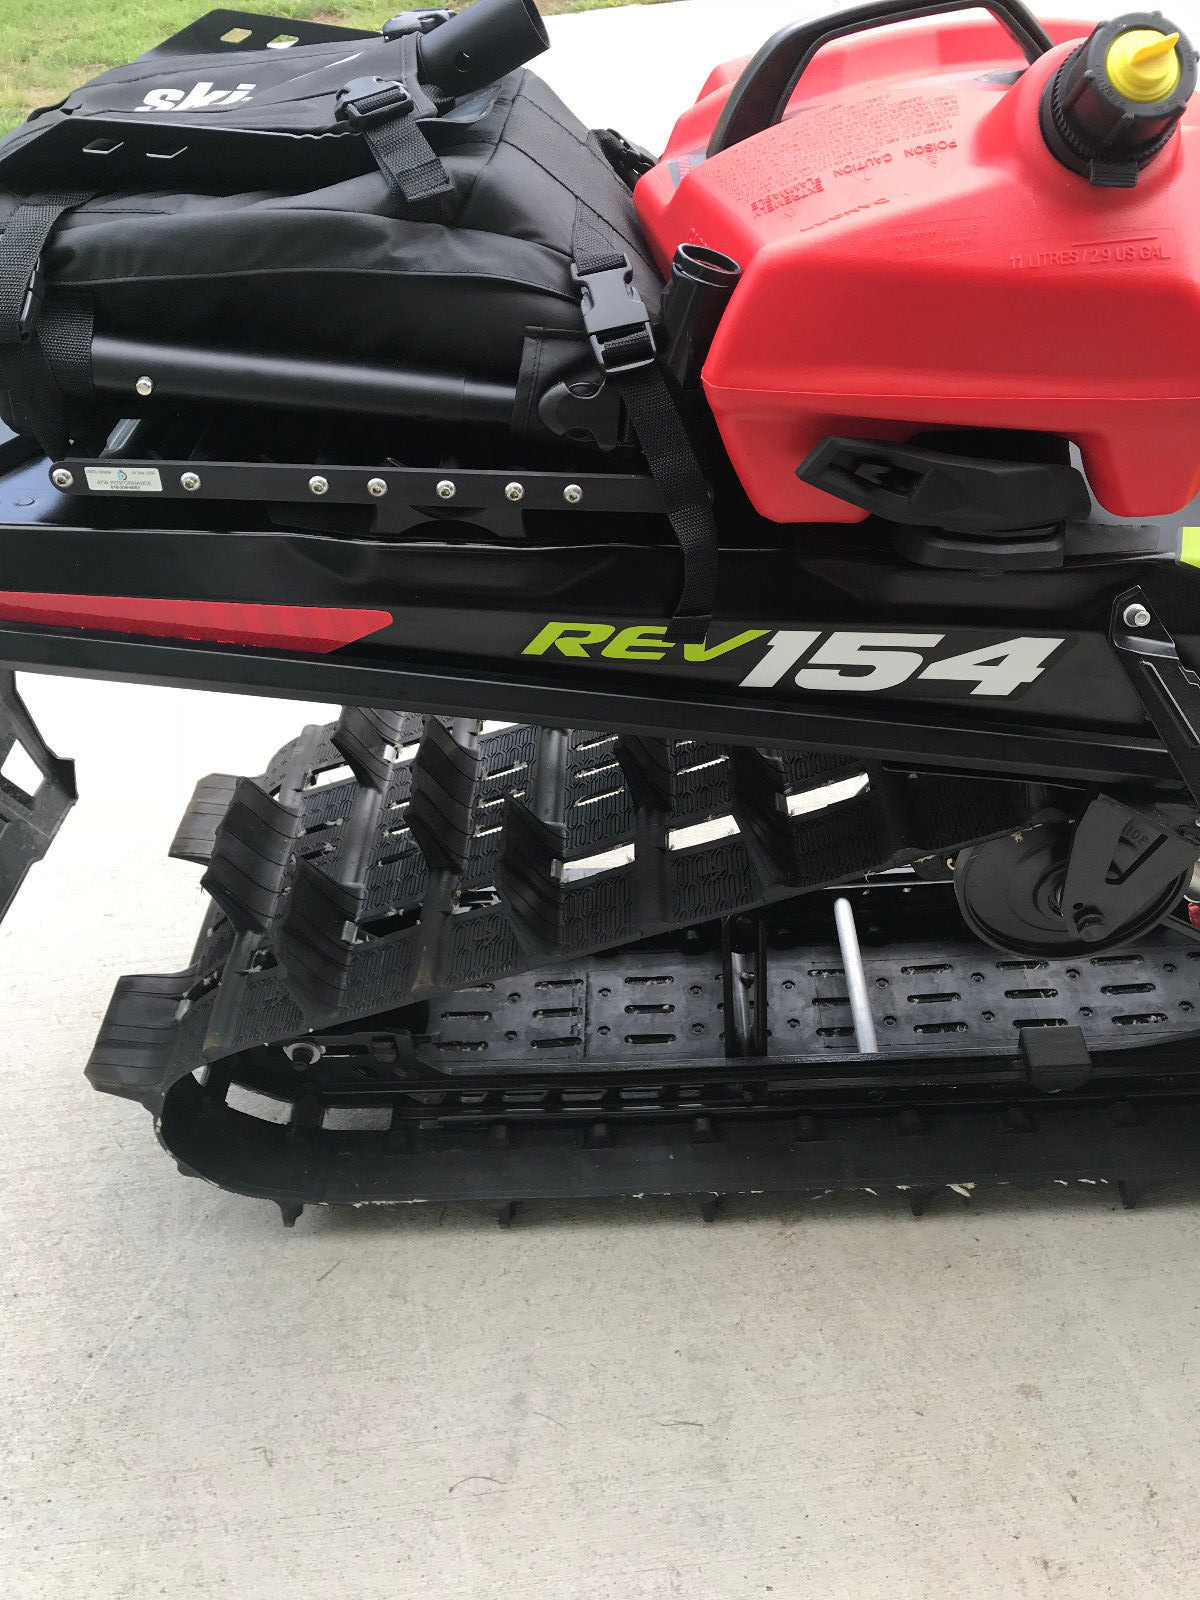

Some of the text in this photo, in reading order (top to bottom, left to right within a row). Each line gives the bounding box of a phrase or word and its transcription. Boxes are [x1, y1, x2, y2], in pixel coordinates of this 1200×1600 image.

[903, 139, 959, 159] POISON
[832, 152, 893, 178] CAUTION
[1115, 245, 1137, 263] US
[1140, 243, 1171, 261] GAL
[521, 621, 1065, 697] REV 154
